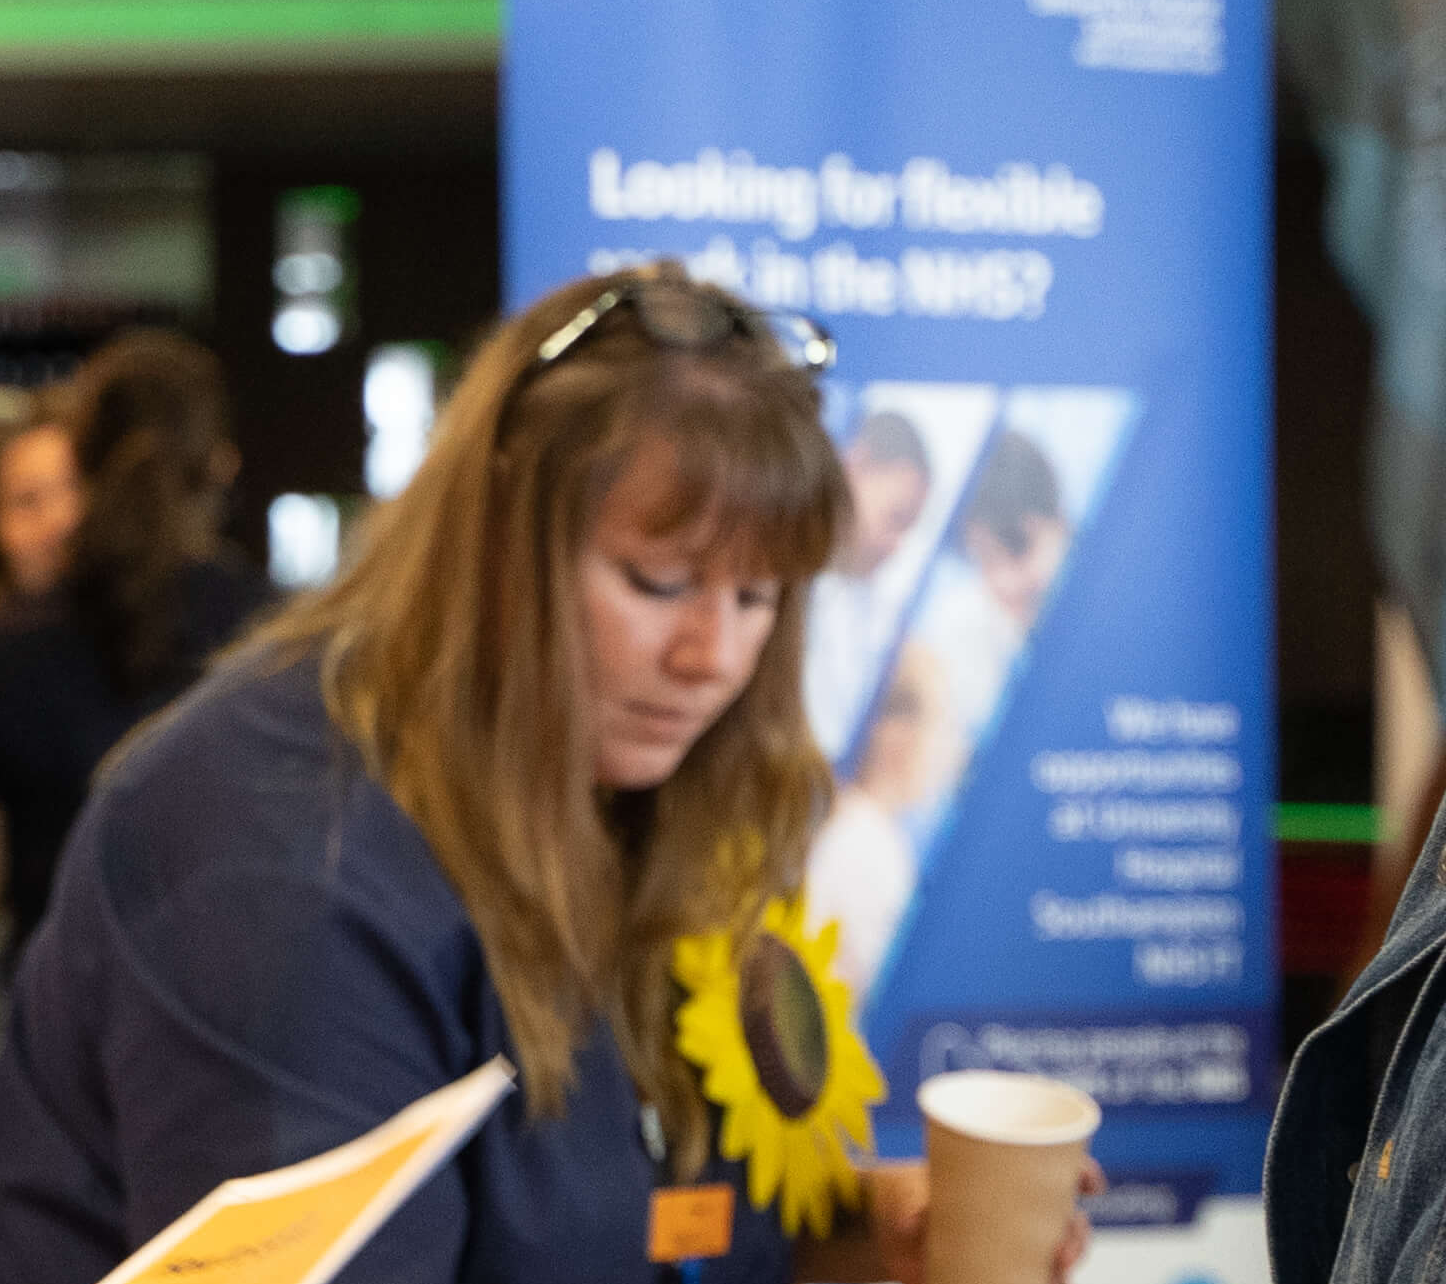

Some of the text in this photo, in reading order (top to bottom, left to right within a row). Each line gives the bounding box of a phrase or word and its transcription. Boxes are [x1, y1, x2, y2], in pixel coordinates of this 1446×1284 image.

[592, 150, 1102, 238] Looking for flexible
[814, 244, 896, 313] the
[903, 250, 1050, 317] NHS?
